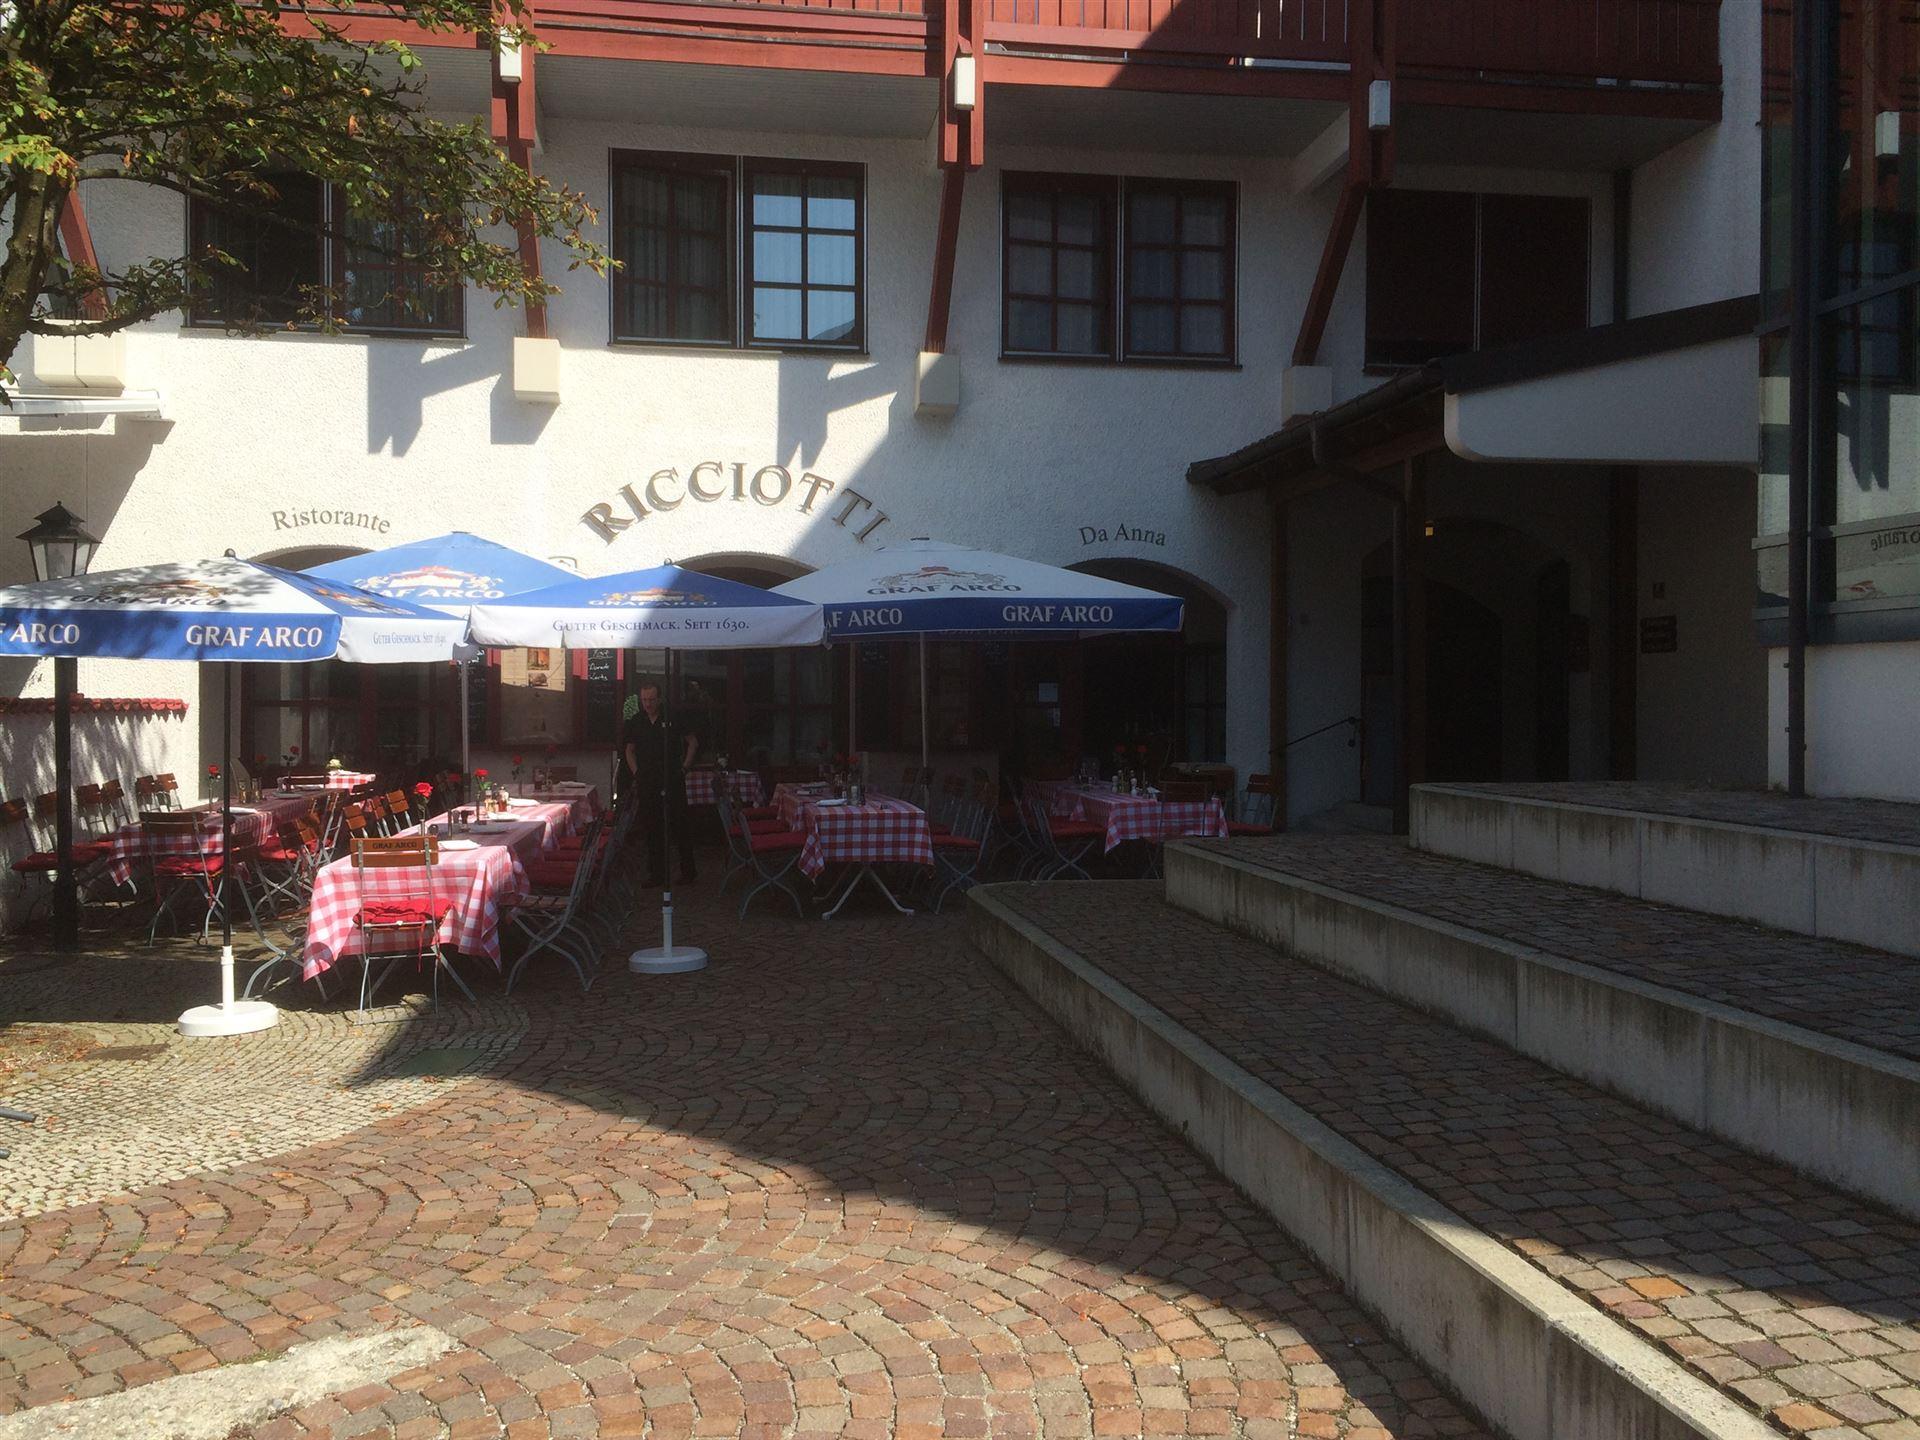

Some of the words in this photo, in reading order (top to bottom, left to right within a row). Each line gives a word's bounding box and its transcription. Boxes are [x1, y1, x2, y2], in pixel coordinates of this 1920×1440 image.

[579, 461, 890, 546] RICCIOTTI
[272, 506, 391, 534] Ristorante
[1079, 526, 1109, 546] Da
[1114, 522, 1166, 546] Anna
[419, 588, 505, 599] ARCO
[867, 585, 942, 595] GRAF
[949, 584, 1022, 592] ARCO
[848, 608, 903, 627] ARCO
[1002, 605, 1056, 623] GRAF
[1059, 605, 1114, 623] ARCO
[9, 622, 80, 645] ARCO
[185, 624, 253, 647] GRAF
[255, 626, 323, 648] ARCO
[716, 618, 751, 633] 1630.
